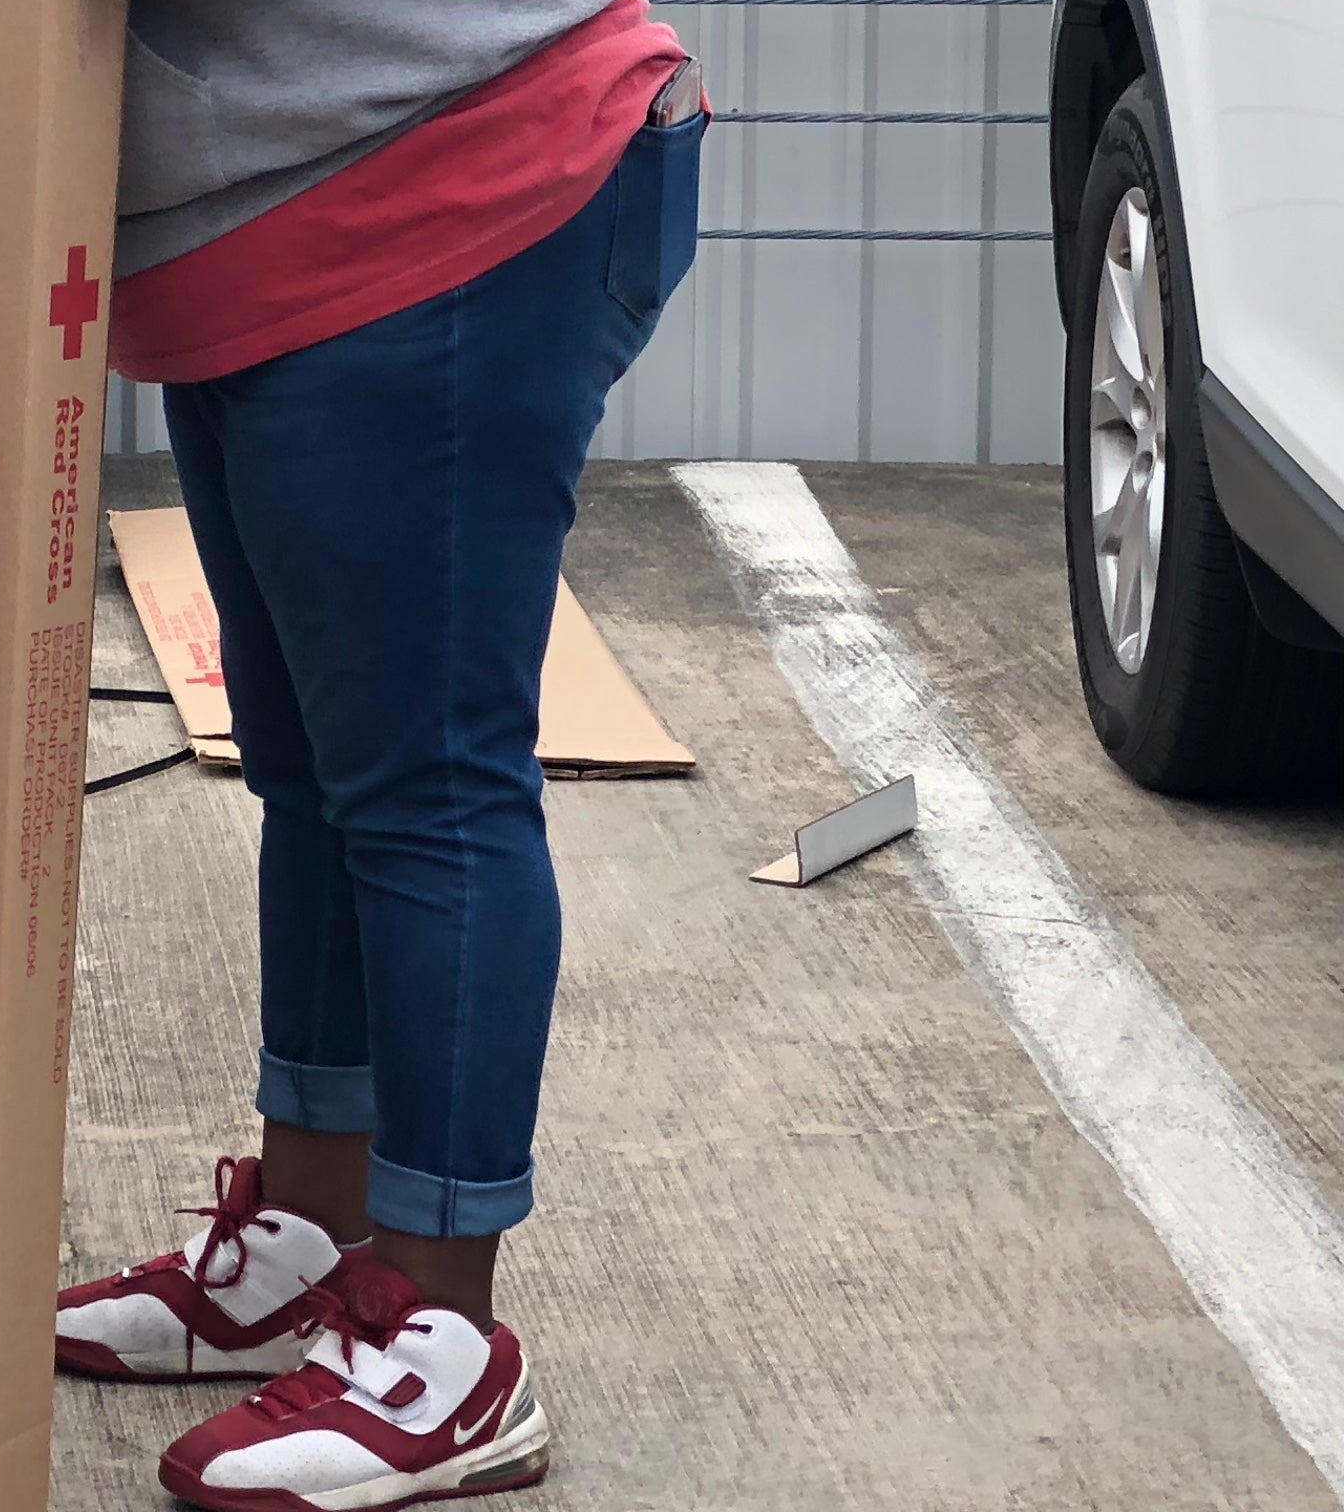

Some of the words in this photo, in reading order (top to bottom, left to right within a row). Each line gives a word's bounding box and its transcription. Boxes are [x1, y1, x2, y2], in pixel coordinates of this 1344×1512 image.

[53, 398, 70, 475] Red
[62, 394, 85, 591] American
[47, 490, 65, 605] Cross
[23, 631, 40, 769] PURCHASE
[39, 628, 52, 693] DATE
[37, 701, 49, 730] OF
